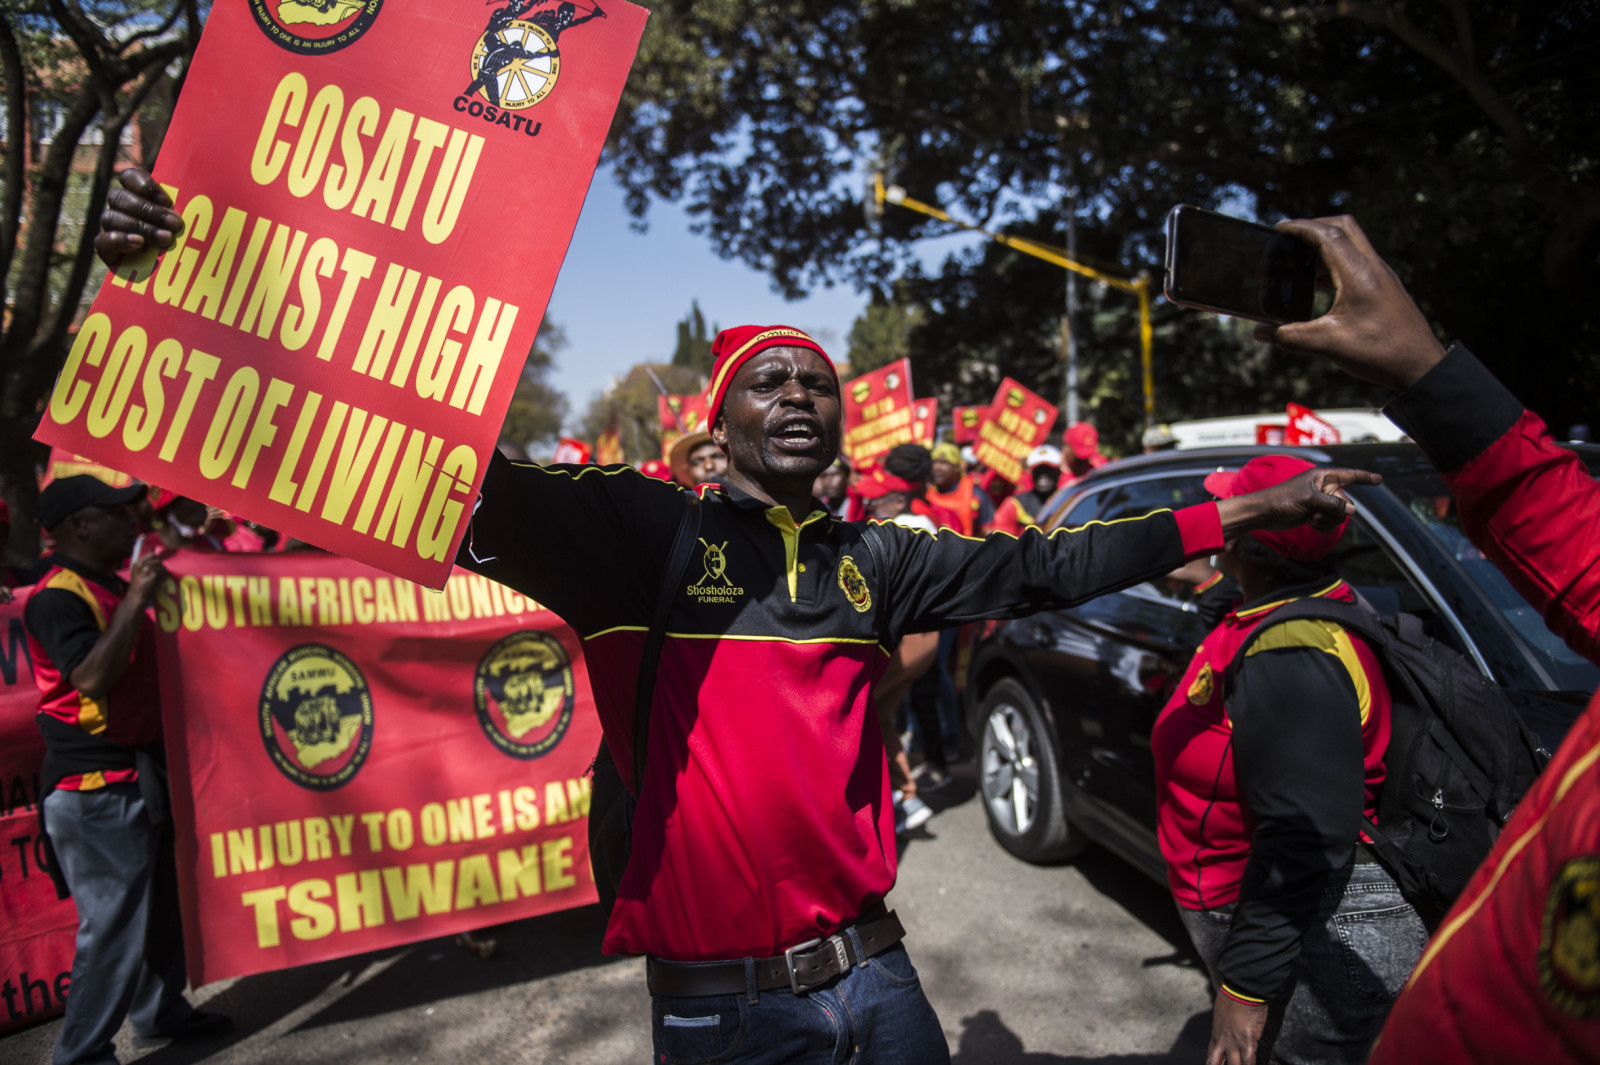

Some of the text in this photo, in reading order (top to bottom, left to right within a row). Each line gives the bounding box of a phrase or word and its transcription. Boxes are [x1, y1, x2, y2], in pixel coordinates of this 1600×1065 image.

[270, 25, 280, 34] TO
[279, 33, 292, 43] ONE
[293, 38, 300, 46] IS
[314, 40, 336, 48] INJURY
[337, 35, 347, 43] TO
[348, 27, 360, 38] ALL
[527, 24, 545, 37] INJURY
[453, 96, 542, 137] COSATU
[536, 90, 547, 100] ALL
[250, 71, 486, 245] COSATU
[351, 262, 520, 417] HIGH
[49, 312, 479, 563] COST OF LIVING
[155, 574, 548, 632] SOUTH AFRICAN MUNIC
[686, 585, 744, 596] Shosholoza
[290, 668, 336, 682] SAMWU
[210, 776, 592, 878] INJURY TO ONE IS AN
[241, 835, 576, 949] TSHWANE
[1, 971, 73, 1020] the
